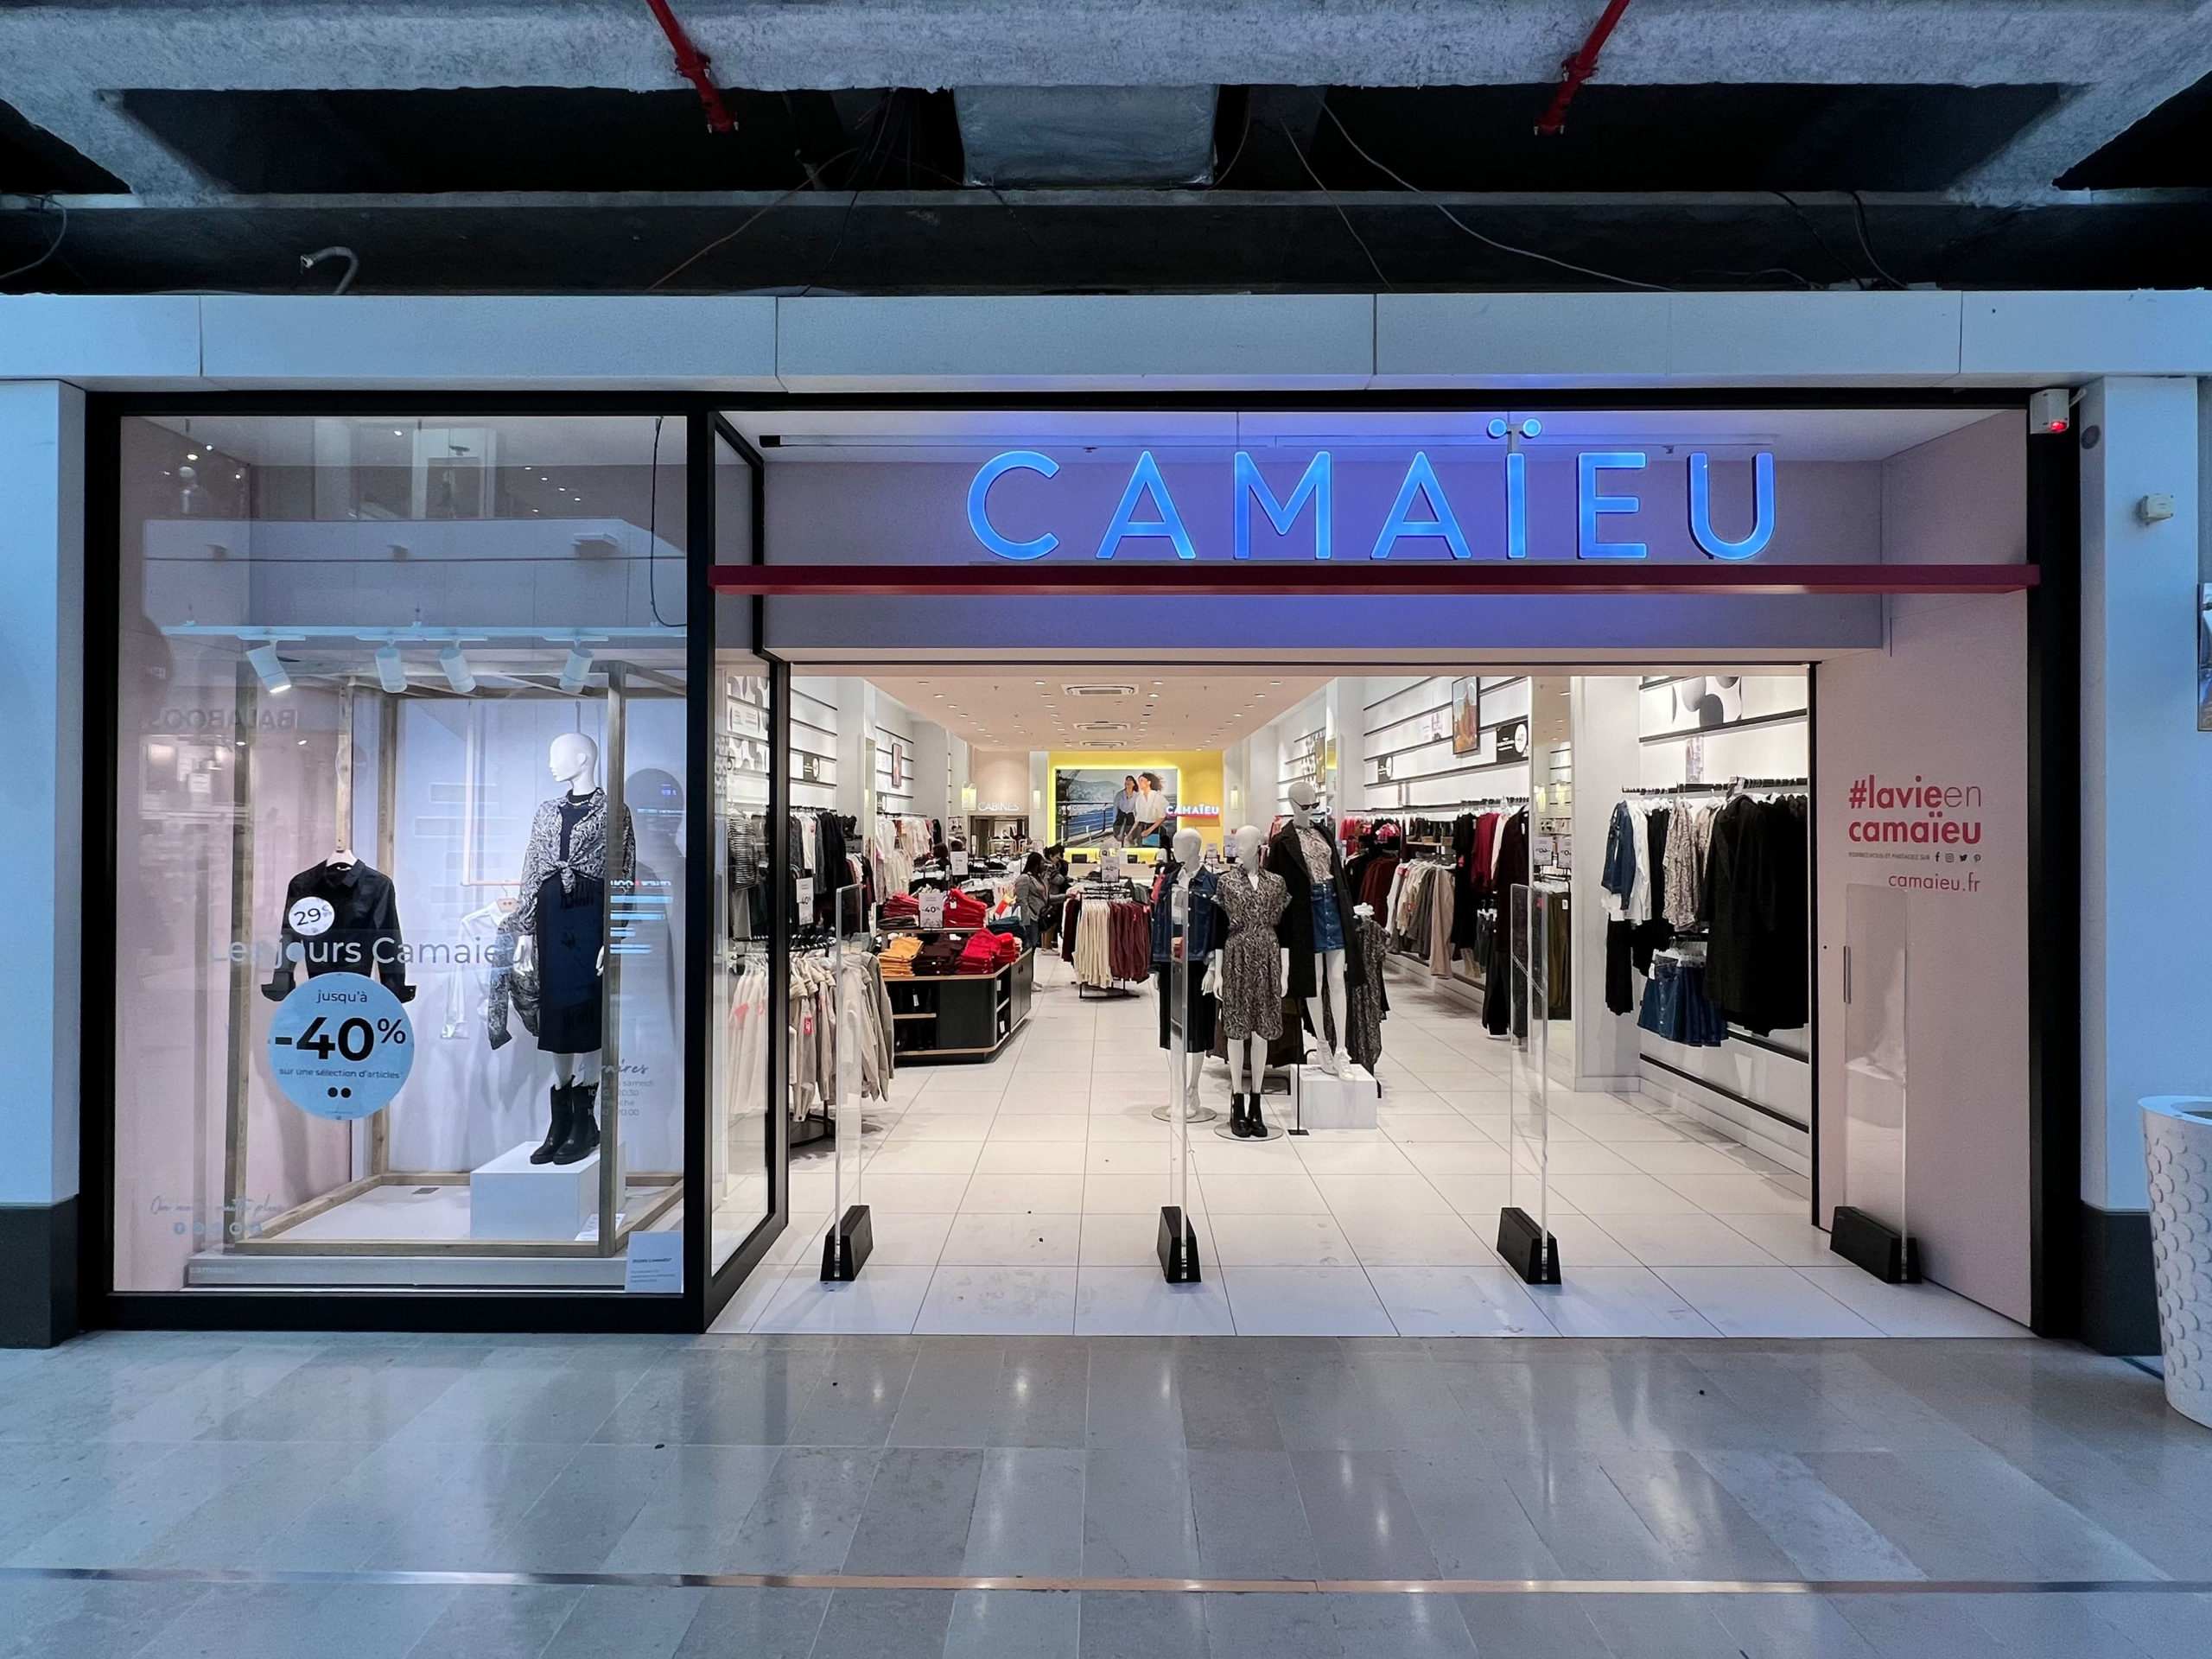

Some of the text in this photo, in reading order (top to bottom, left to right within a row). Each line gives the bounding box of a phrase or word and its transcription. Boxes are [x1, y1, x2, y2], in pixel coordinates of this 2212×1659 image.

[966, 417, 1776, 561] CAMAÏEU
[977, 802, 1020, 811] CABINES
[1848, 810, 1981, 844] camaïeu
[1888, 872, 1981, 893] camaieu.fr
[316, 989, 368, 1005] jusqu'à
[275, 1017, 407, 1062] -40%
[296, 1068, 314, 1077] une
[315, 1067, 358, 1078] sélection
